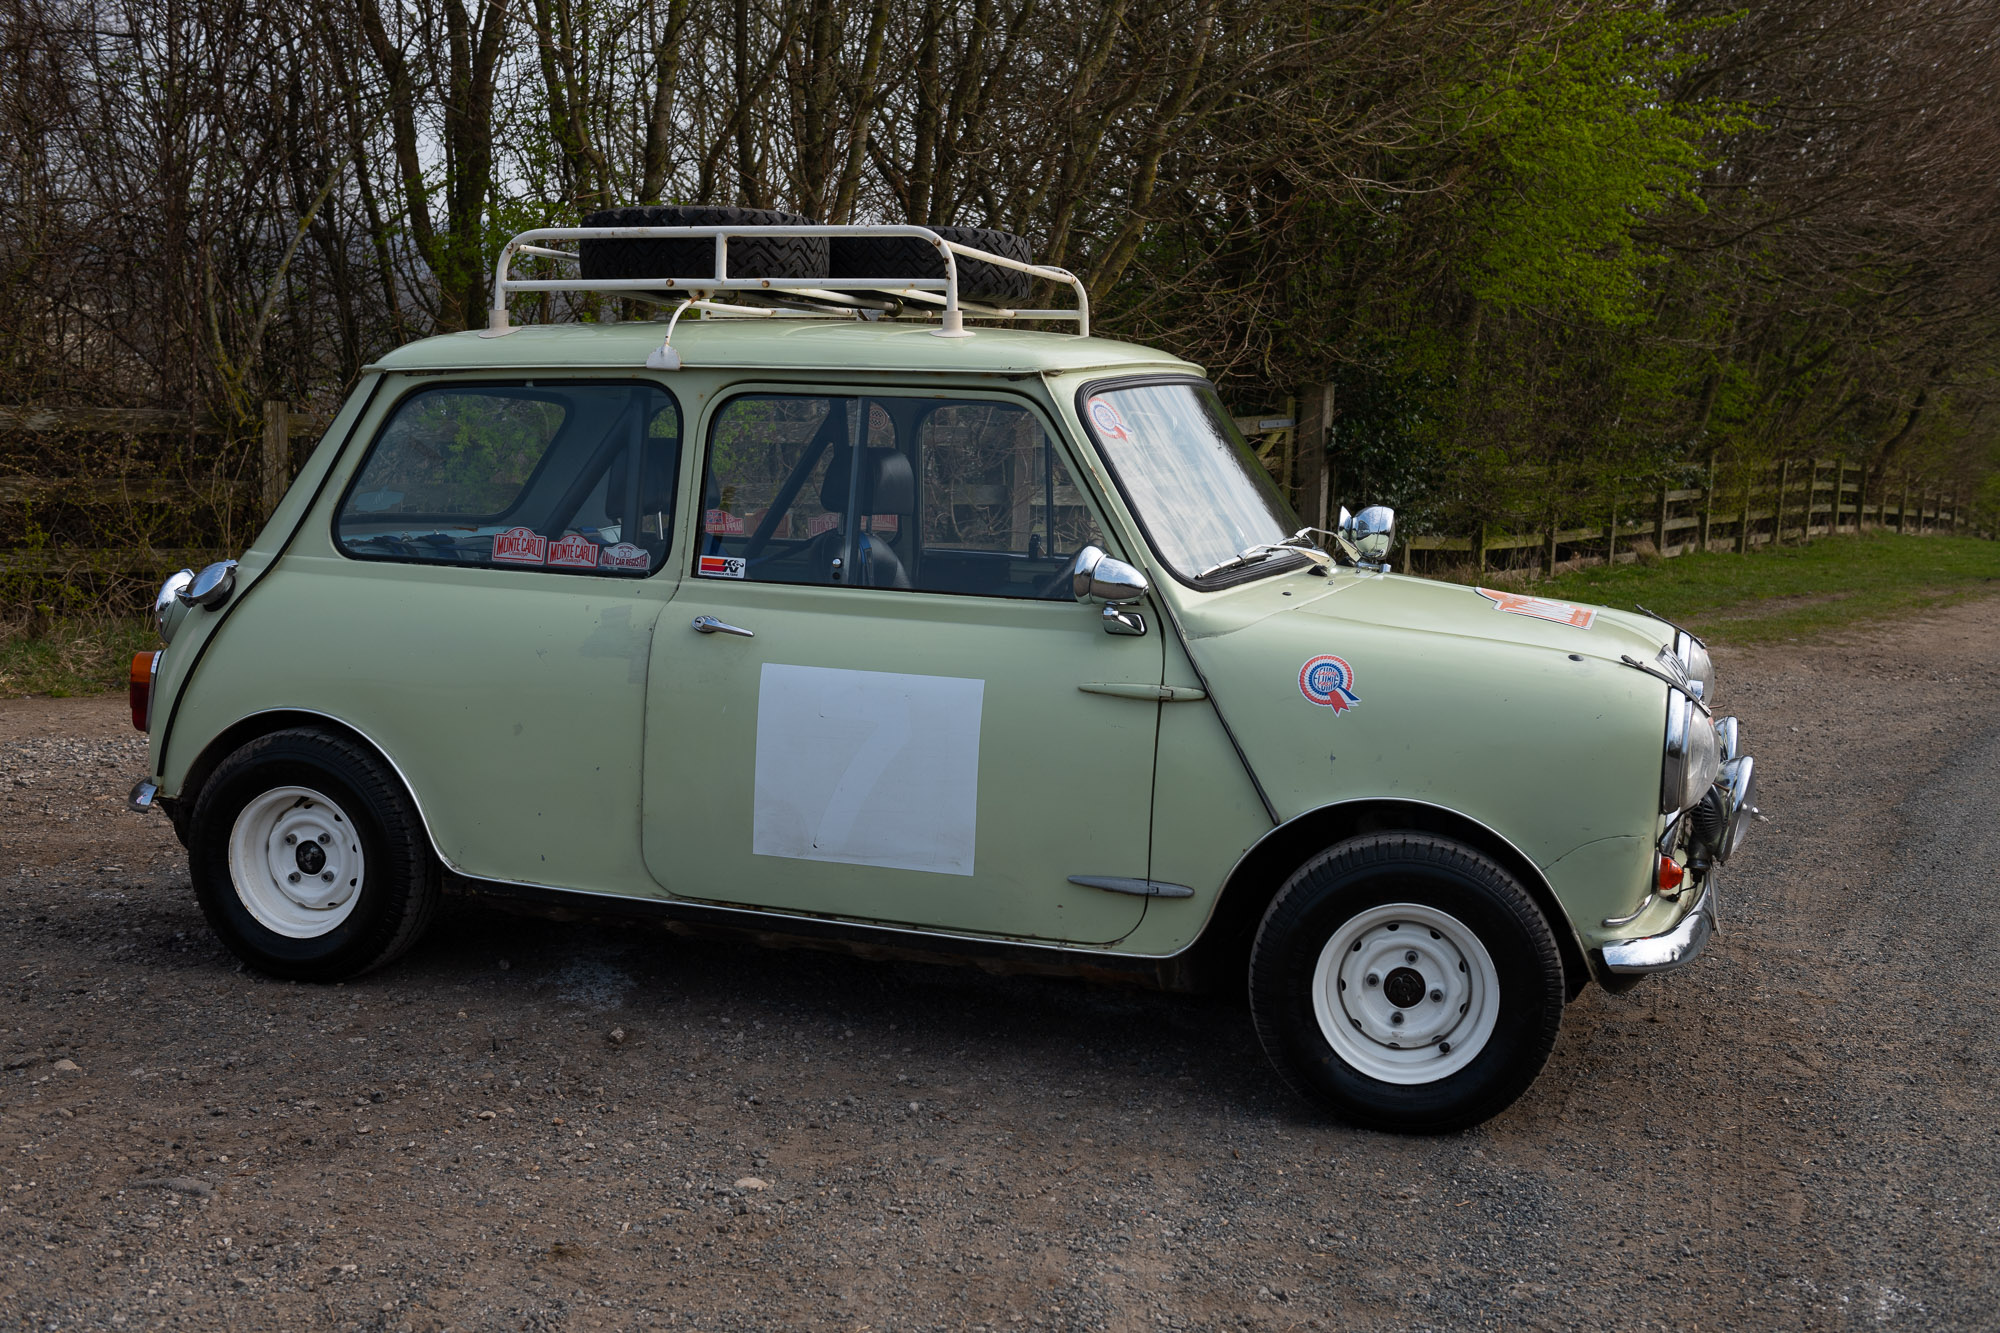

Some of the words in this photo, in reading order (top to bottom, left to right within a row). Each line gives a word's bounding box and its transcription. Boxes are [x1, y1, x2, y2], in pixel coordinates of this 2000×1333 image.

[496, 536, 521, 556] MONTE
[521, 538, 543, 558] CARLO
[550, 543, 574, 562] MONTE
[575, 544, 596, 564] CARLO
[601, 550, 615, 565] RALLY
[615, 557, 625, 566] CAR
